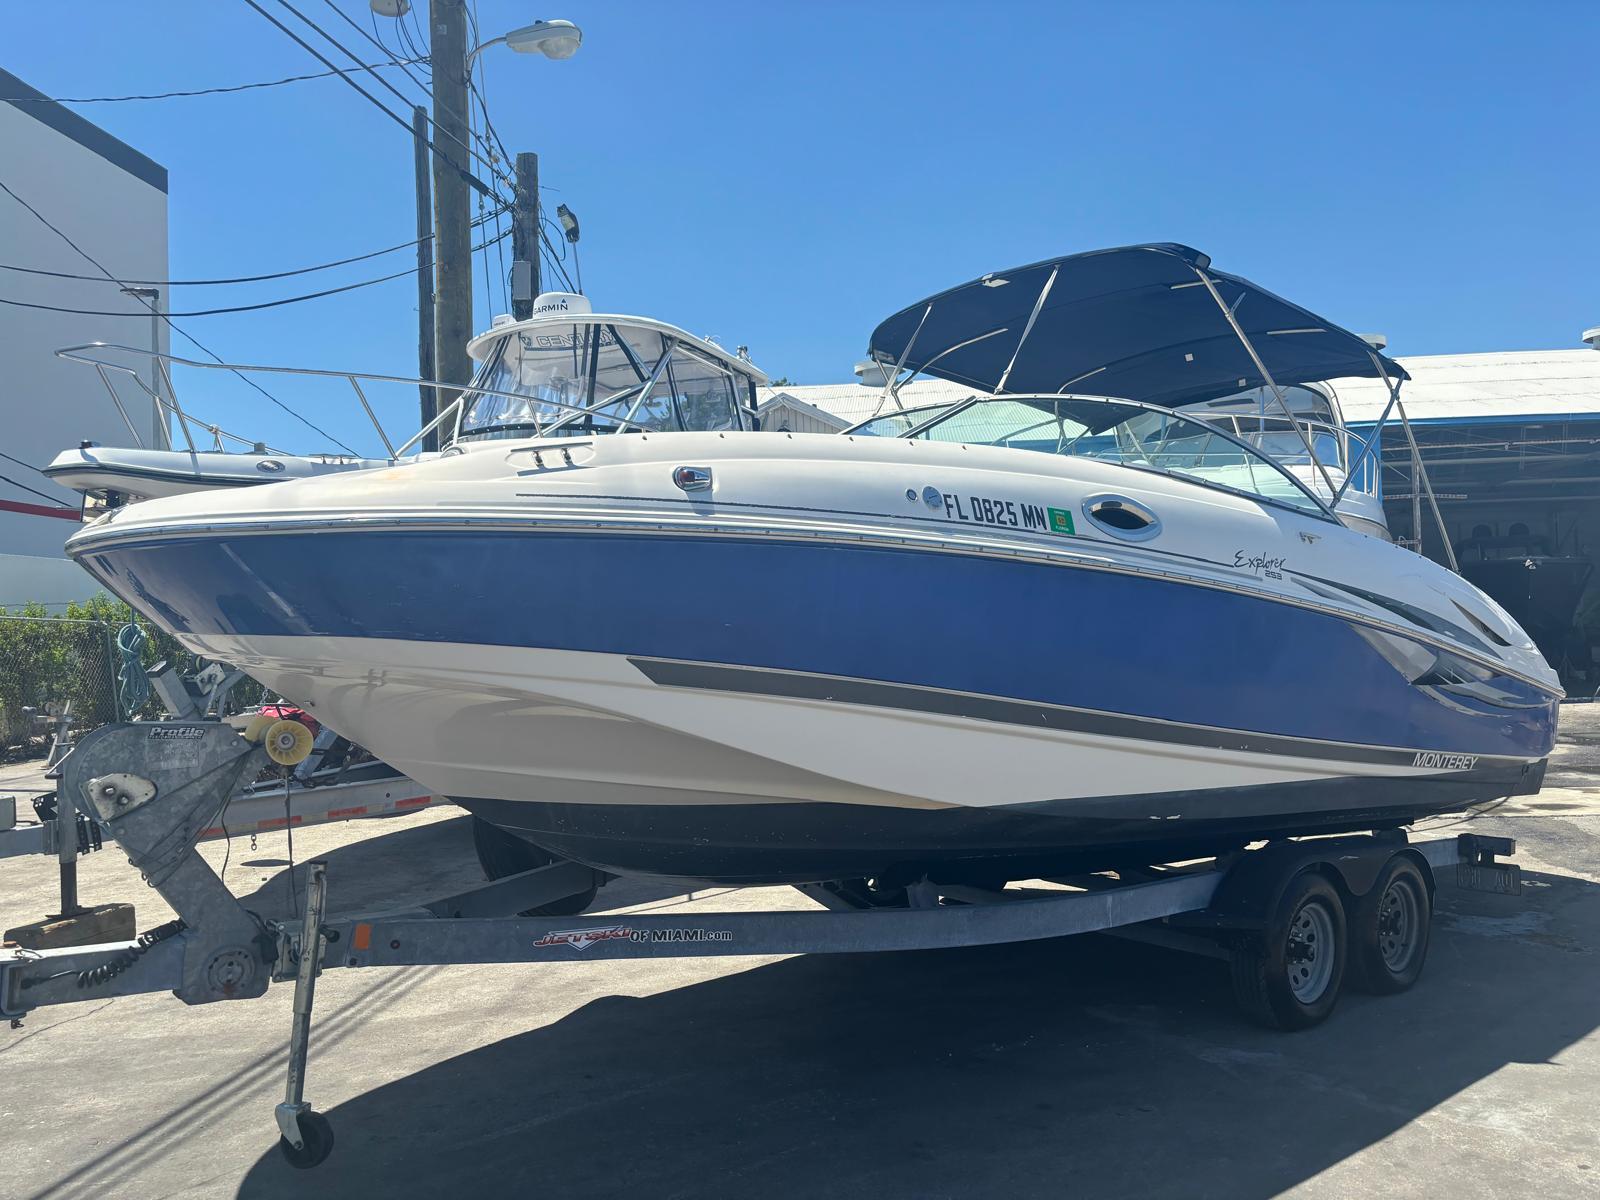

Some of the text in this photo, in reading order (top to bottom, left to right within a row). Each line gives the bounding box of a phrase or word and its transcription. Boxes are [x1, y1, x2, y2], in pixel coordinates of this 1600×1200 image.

[534, 303, 569, 314] GARMIN
[942, 493, 1048, 530] FL 0825 MN
[1233, 549, 1287, 575] Explorer
[1264, 570, 1283, 581] 253
[149, 726, 205, 737] Profile
[1412, 752, 1479, 770] MONTEREY
[533, 927, 632, 947] JETSKI
[629, 930, 649, 943] OF
